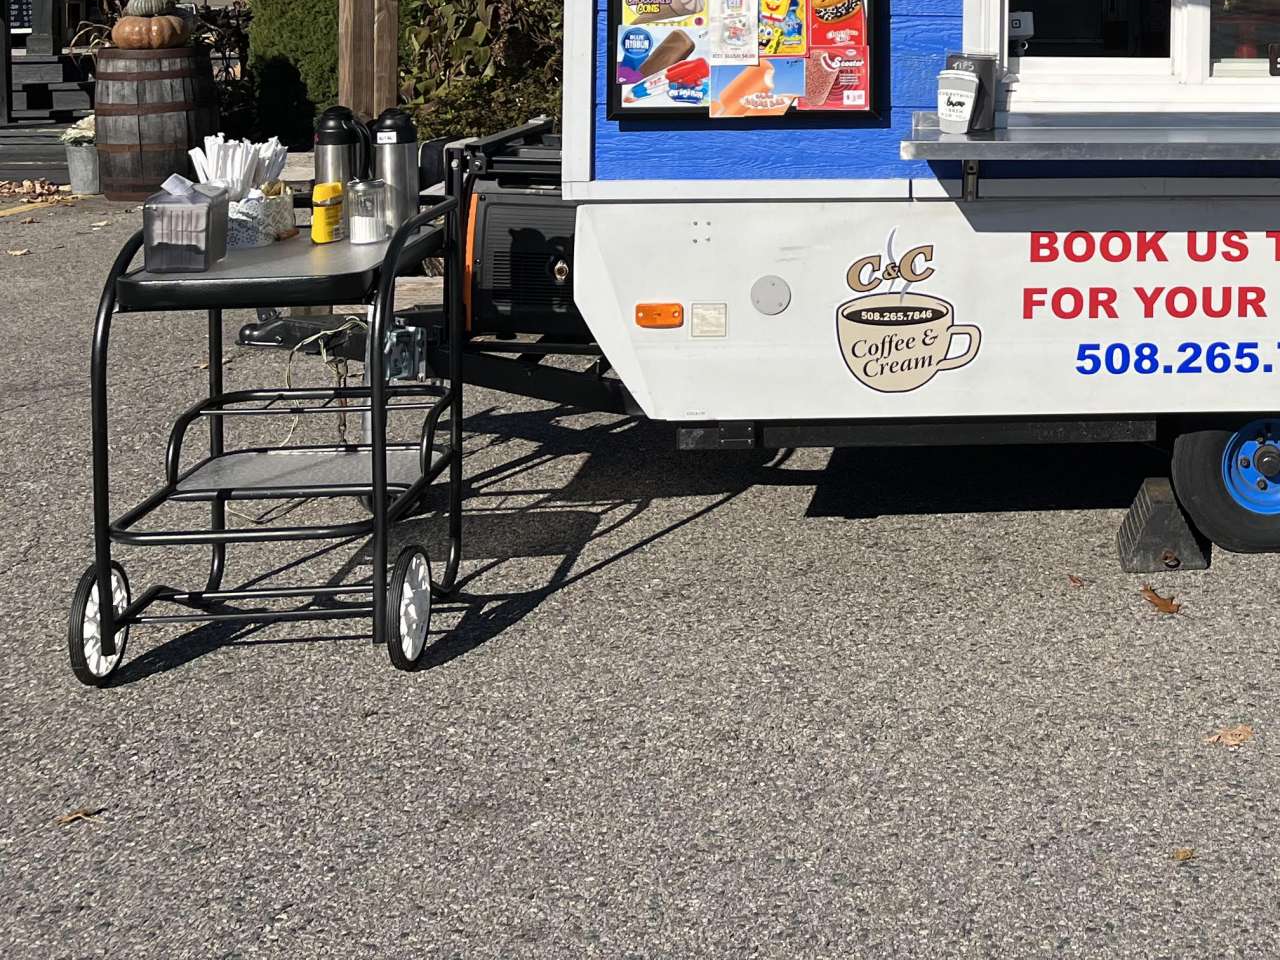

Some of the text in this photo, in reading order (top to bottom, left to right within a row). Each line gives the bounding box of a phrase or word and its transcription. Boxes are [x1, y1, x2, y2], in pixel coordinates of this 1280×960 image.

[1029, 230, 1169, 263] BOOK
[1187, 230, 1250, 262] US
[861, 308, 932, 321] 508.265.7846
[1021, 286, 1119, 320] FOR
[1133, 285, 1268, 320] YOUR
[851, 328, 939, 360] Coffee &
[862, 354, 933, 378] Cream
